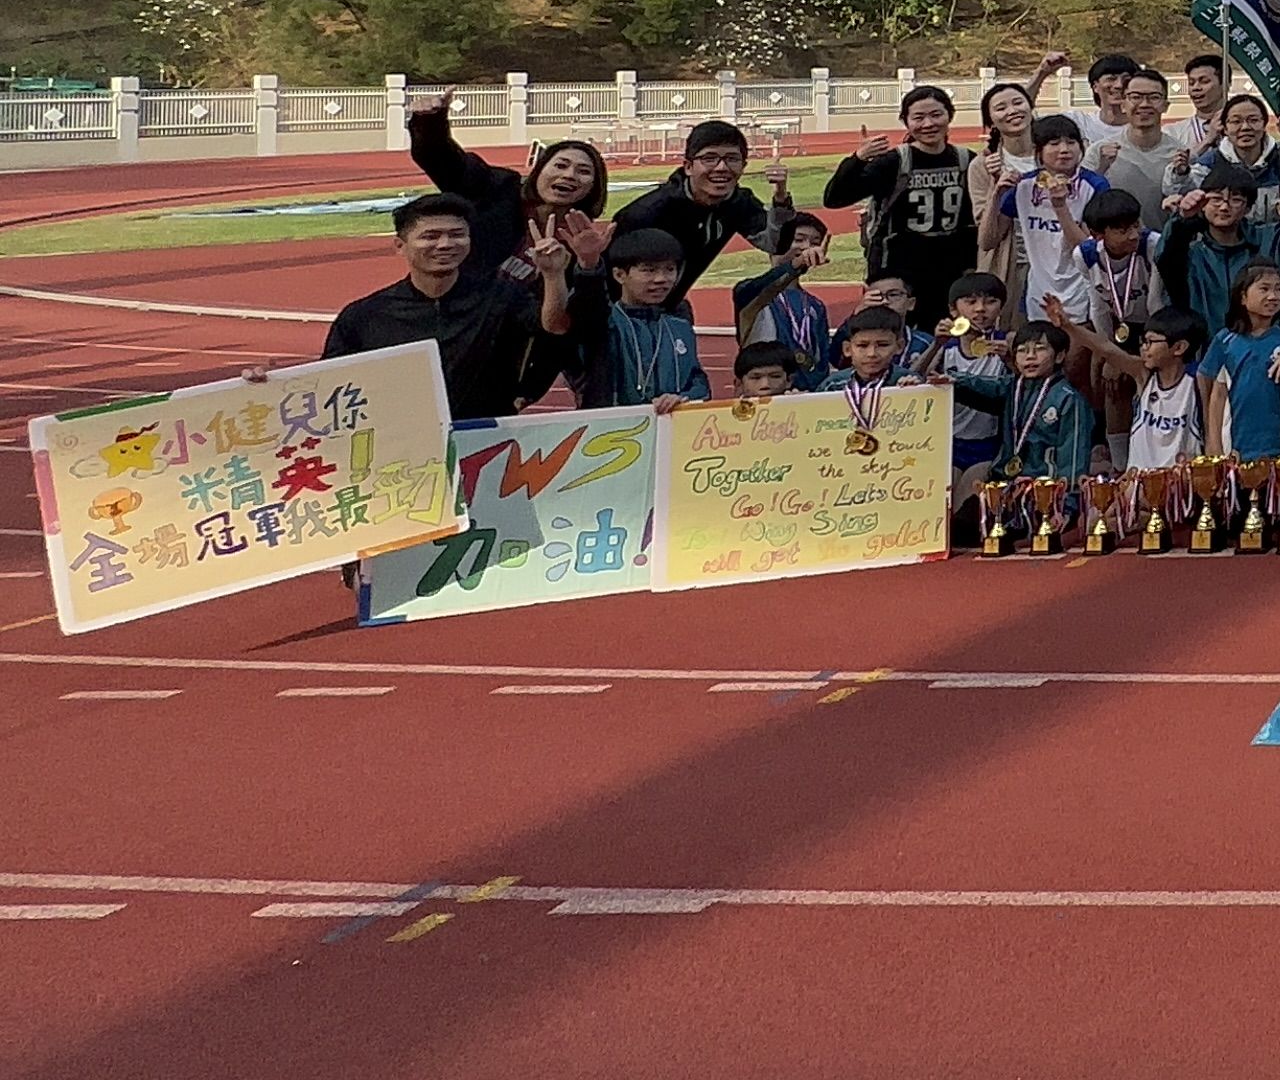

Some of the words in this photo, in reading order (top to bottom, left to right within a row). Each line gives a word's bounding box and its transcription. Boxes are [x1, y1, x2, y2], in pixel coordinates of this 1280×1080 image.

[907, 186, 964, 232] 39
[459, 415, 650, 508] TWS
[684, 456, 793, 497] Together
[818, 463, 844, 479] the
[860, 457, 899, 481] sky
[809, 509, 879, 538] Sing
